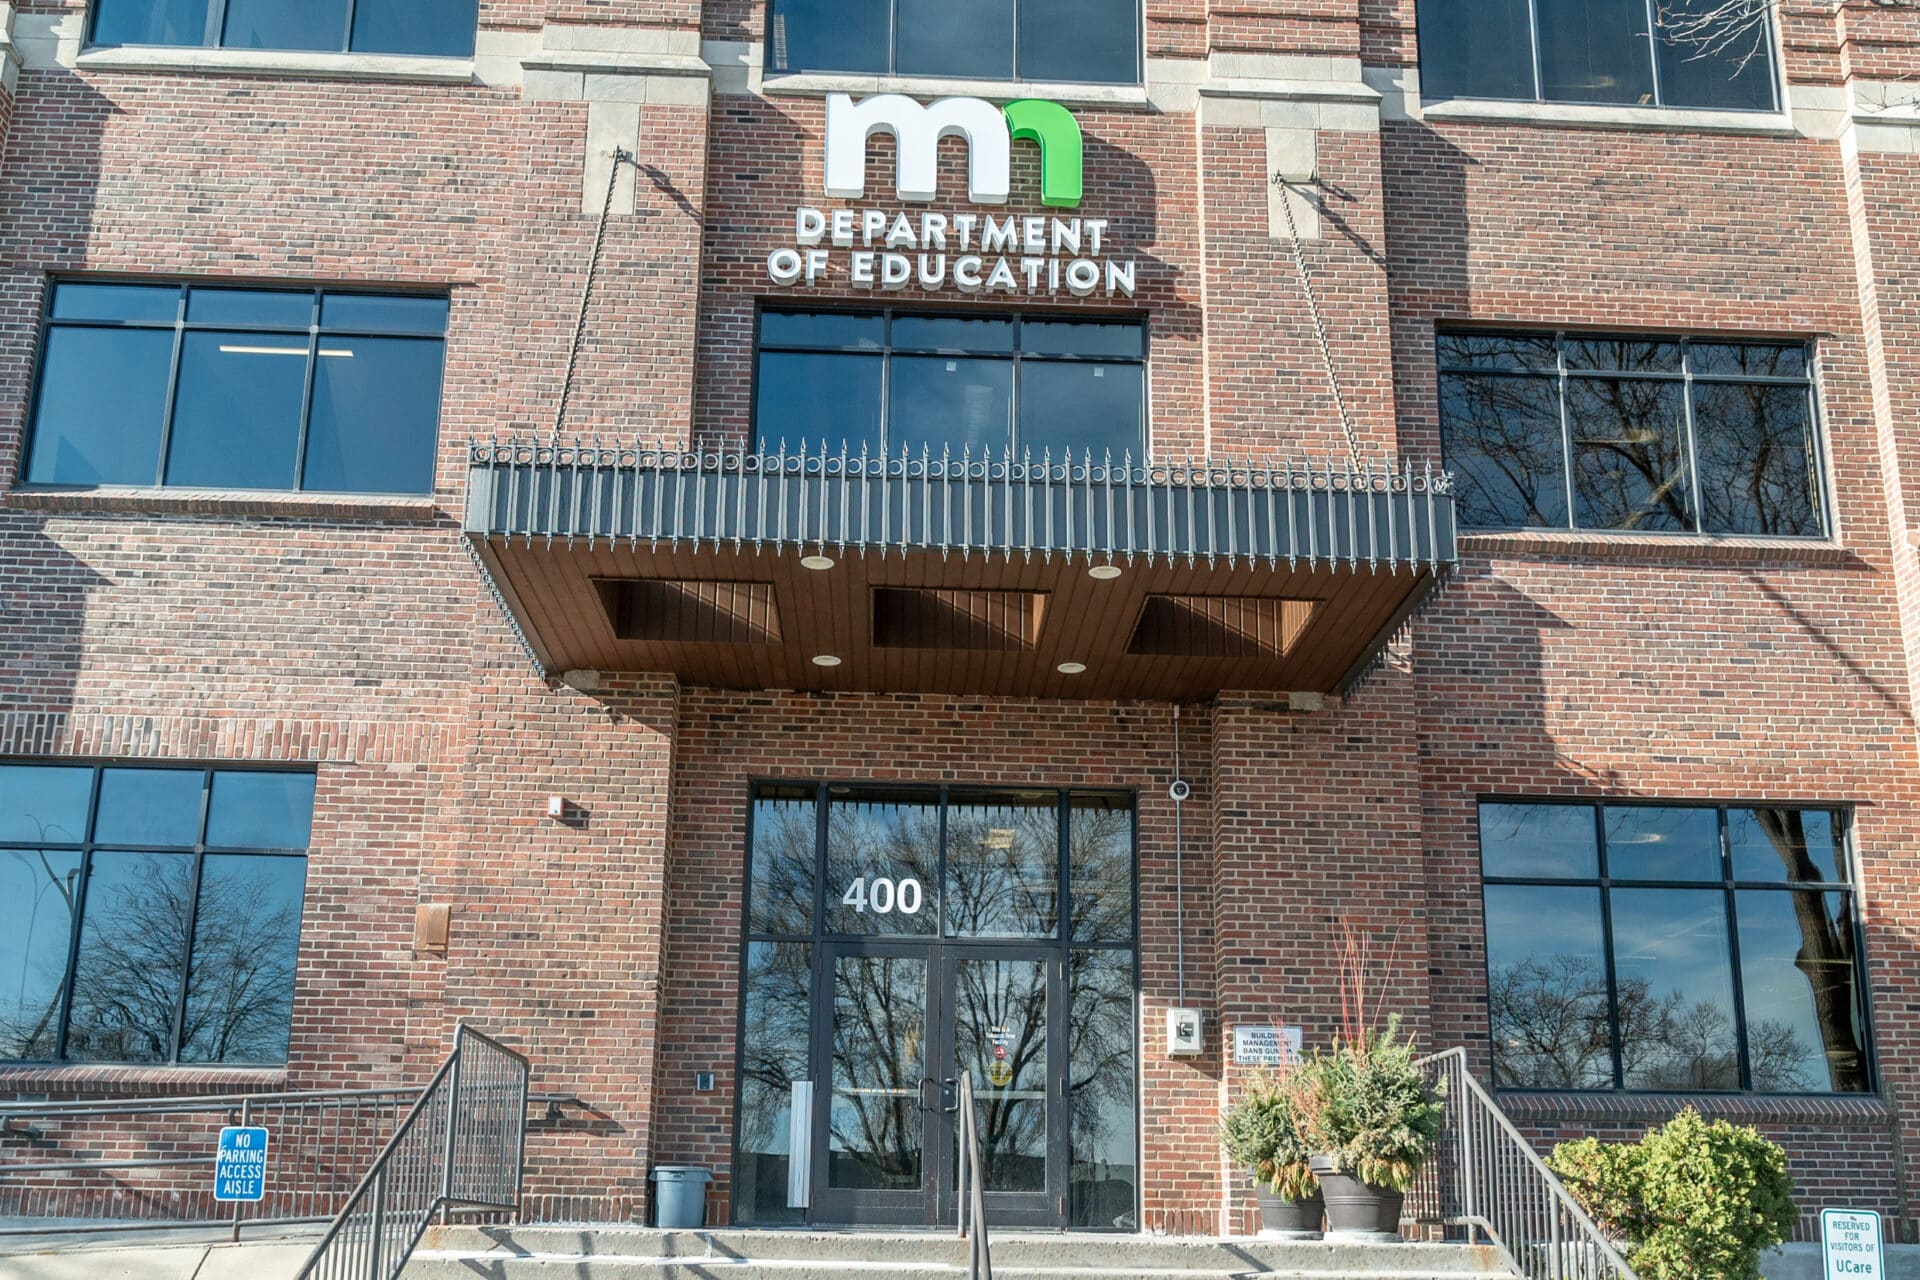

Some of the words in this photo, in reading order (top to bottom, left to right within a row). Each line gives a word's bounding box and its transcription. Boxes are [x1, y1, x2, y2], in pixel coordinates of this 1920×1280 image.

[796, 207, 1108, 256] DEPARTMENT
[767, 248, 827, 287] OF
[851, 251, 1135, 298] EDUCATION
[842, 877, 922, 914] 400
[1243, 1047, 1263, 1055] BANS
[235, 1133, 251, 1148] NO
[219, 1149, 264, 1164] PARKING
[219, 1164, 262, 1179] ACCESS
[223, 1180, 255, 1195] AISLE
[1832, 1221, 1871, 1231] RESERVED
[1844, 1232, 1860, 1241] FOR
[1830, 1242, 1863, 1252] VISITORS
[1865, 1244, 1876, 1253] OF
[1836, 1259, 1873, 1274] UCare
